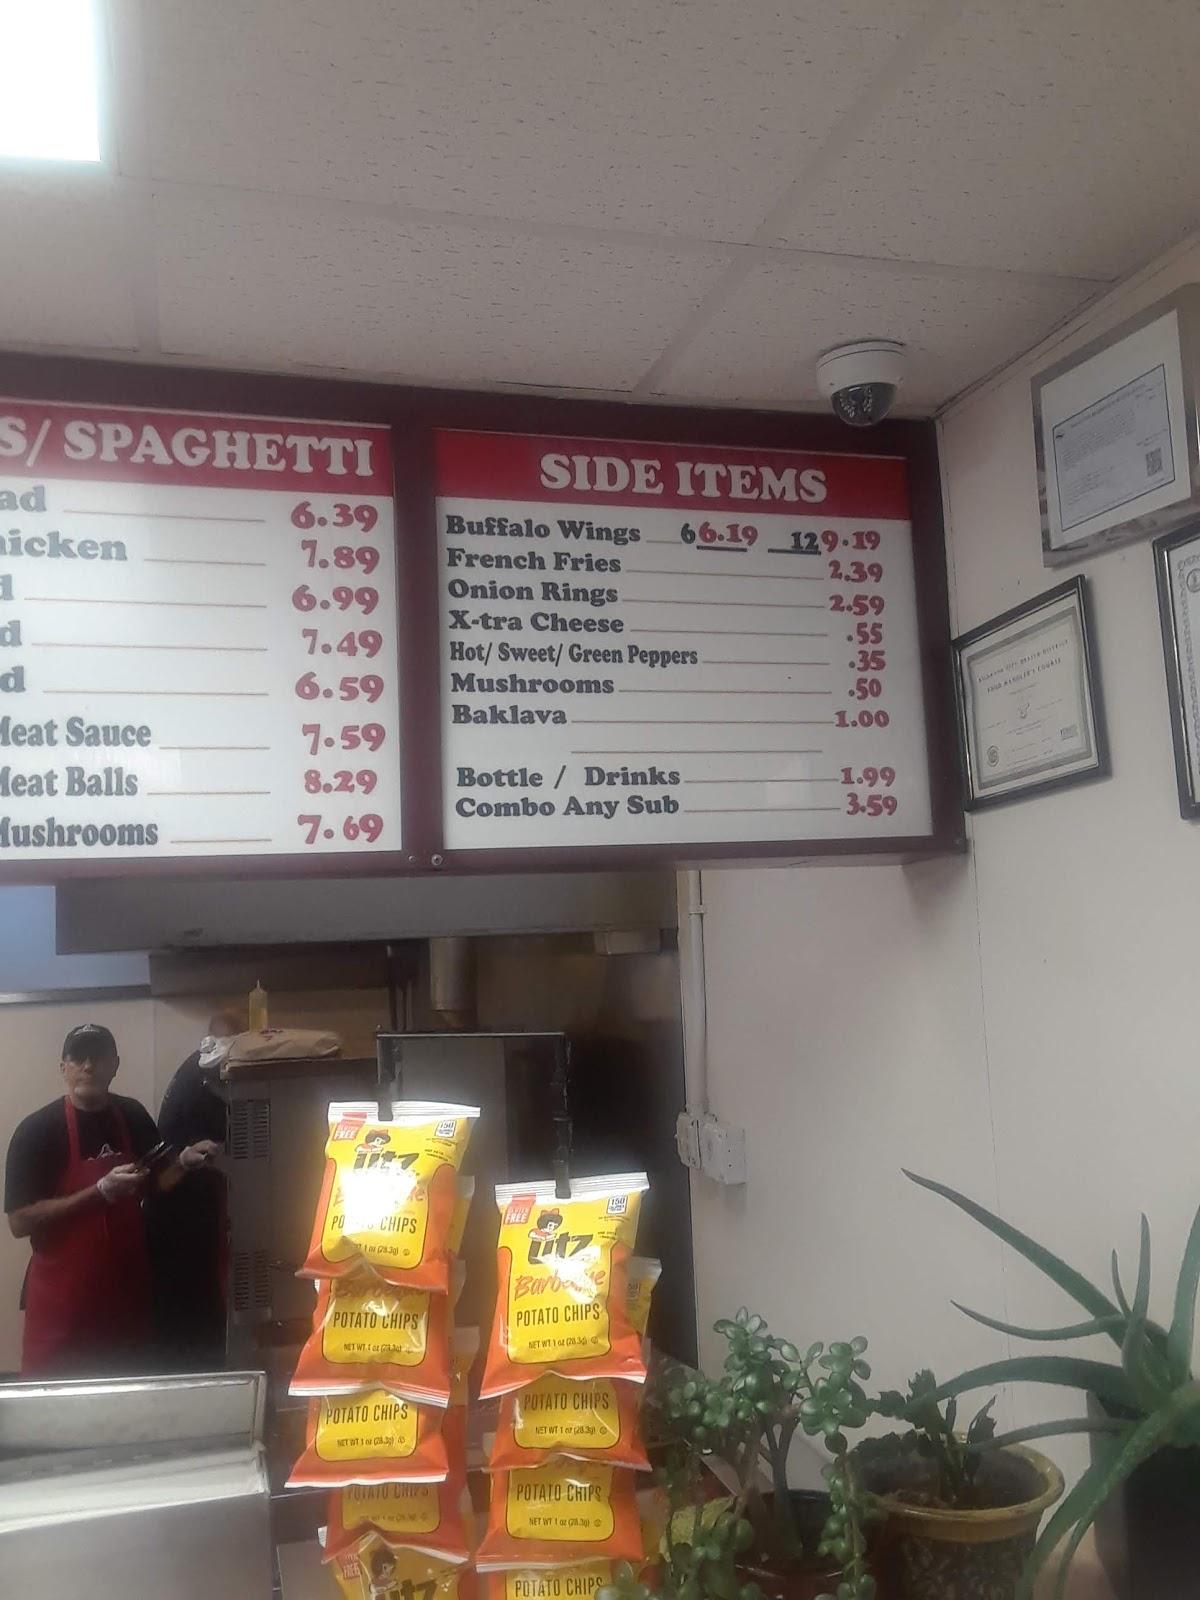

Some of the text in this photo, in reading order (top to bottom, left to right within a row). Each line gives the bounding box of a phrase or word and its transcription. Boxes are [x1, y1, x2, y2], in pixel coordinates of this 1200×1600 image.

[64, 420, 374, 477] SPAGHETTI
[540, 453, 827, 503] SIDE ITEMS
[291, 501, 378, 533] 6.39
[446, 515, 550, 538] Buffalo
[557, 520, 641, 546] Wings
[0, 529, 380, 575] icken 7.89
[446, 547, 883, 583] French Fries 2.39
[292, 584, 379, 615] 6.99
[448, 578, 885, 616] Onion Rings 2.59
[448, 610, 883, 645] X-tra Cheese .55
[302, 628, 383, 658] 7.49
[450, 641, 886, 672] Hot/ Sweet/ Green Peppers .35
[295, 671, 384, 703] 6.59
[451, 672, 882, 700] Mushrooms .50
[452, 704, 889, 728] Baklava 1.00
[66, 716, 151, 747] Sauce
[302, 722, 386, 755] 7.59
[65, 766, 138, 797] Balls
[304, 769, 378, 795] 8.29
[457, 765, 896, 789] Bottle / Drinks 1.99
[456, 792, 898, 819] Combo Any Sub 3.59
[297, 813, 384, 844] 7.69
[380, 1217, 418, 1234] CHIPS
[505, 1214, 528, 1223] FREE
[333, 1311, 419, 1330] POTATO CHIPS
[517, 1303, 600, 1327] POTATO CHIPS
[326, 1403, 409, 1425] POTATO CHIPS
[524, 1392, 609, 1411] POTATO CHIPS
[535, 1426, 548, 1435] NET
[549, 1426, 559, 1434] WT
[516, 1484, 602, 1503] POTATO CHIPS
[529, 1518, 542, 1526] NET
[543, 1518, 553, 1526] WT
[515, 1579, 560, 1598] POTATO
